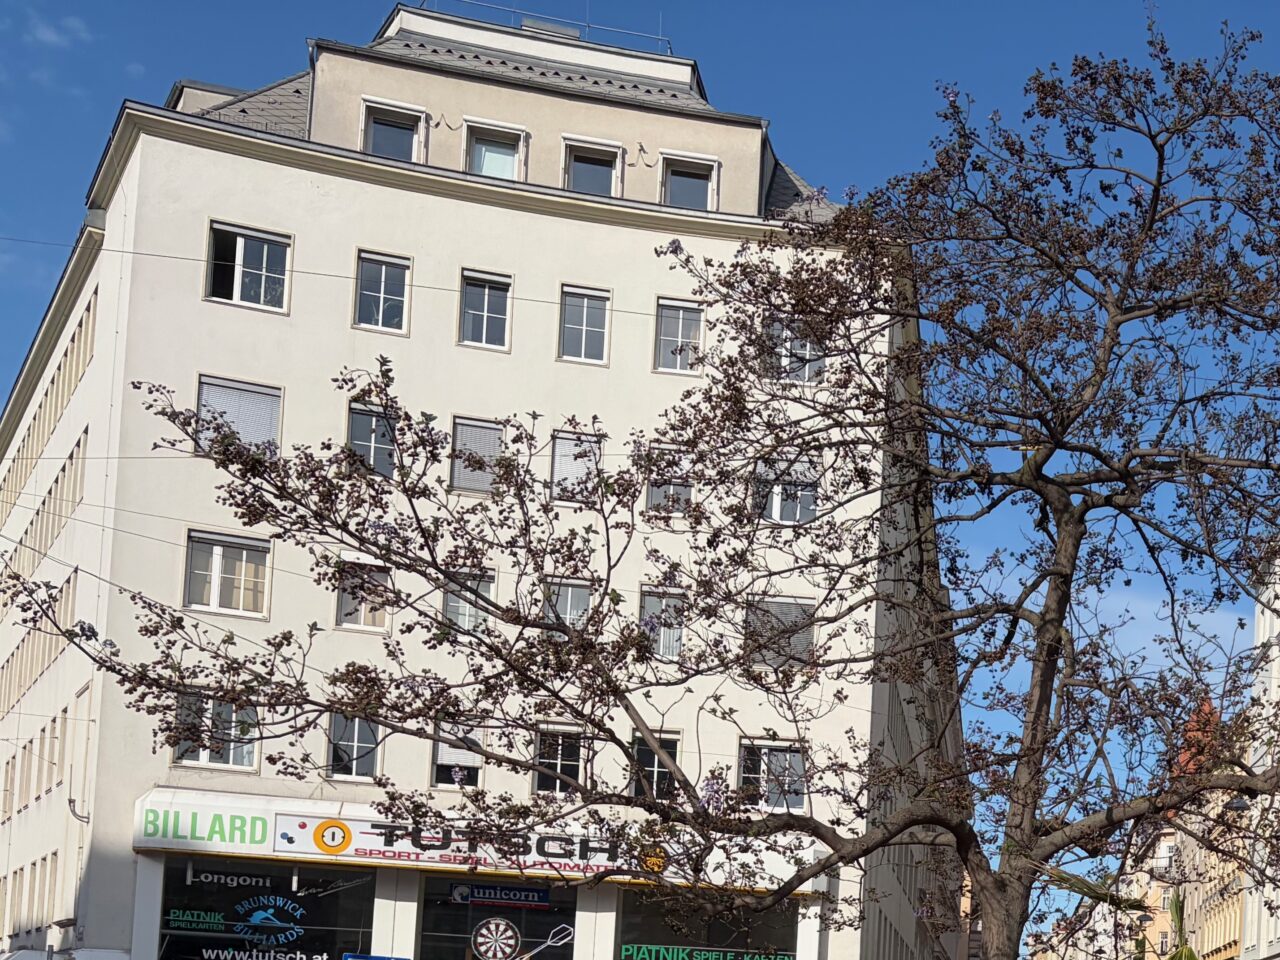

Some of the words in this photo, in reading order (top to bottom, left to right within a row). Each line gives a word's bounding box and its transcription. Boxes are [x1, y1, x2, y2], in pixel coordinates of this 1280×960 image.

[144, 808, 268, 845] BILLARD
[371, 823, 620, 862] TUTSCH
[354, 848, 424, 861] SPORT
[189, 872, 272, 887] Longoni
[473, 886, 539, 901] unicorn
[235, 895, 307, 920] BRUNSWICK
[169, 909, 225, 922] PIATNIK
[169, 920, 225, 931] SPIELKARTEN
[233, 923, 305, 945] BILLIARDS
